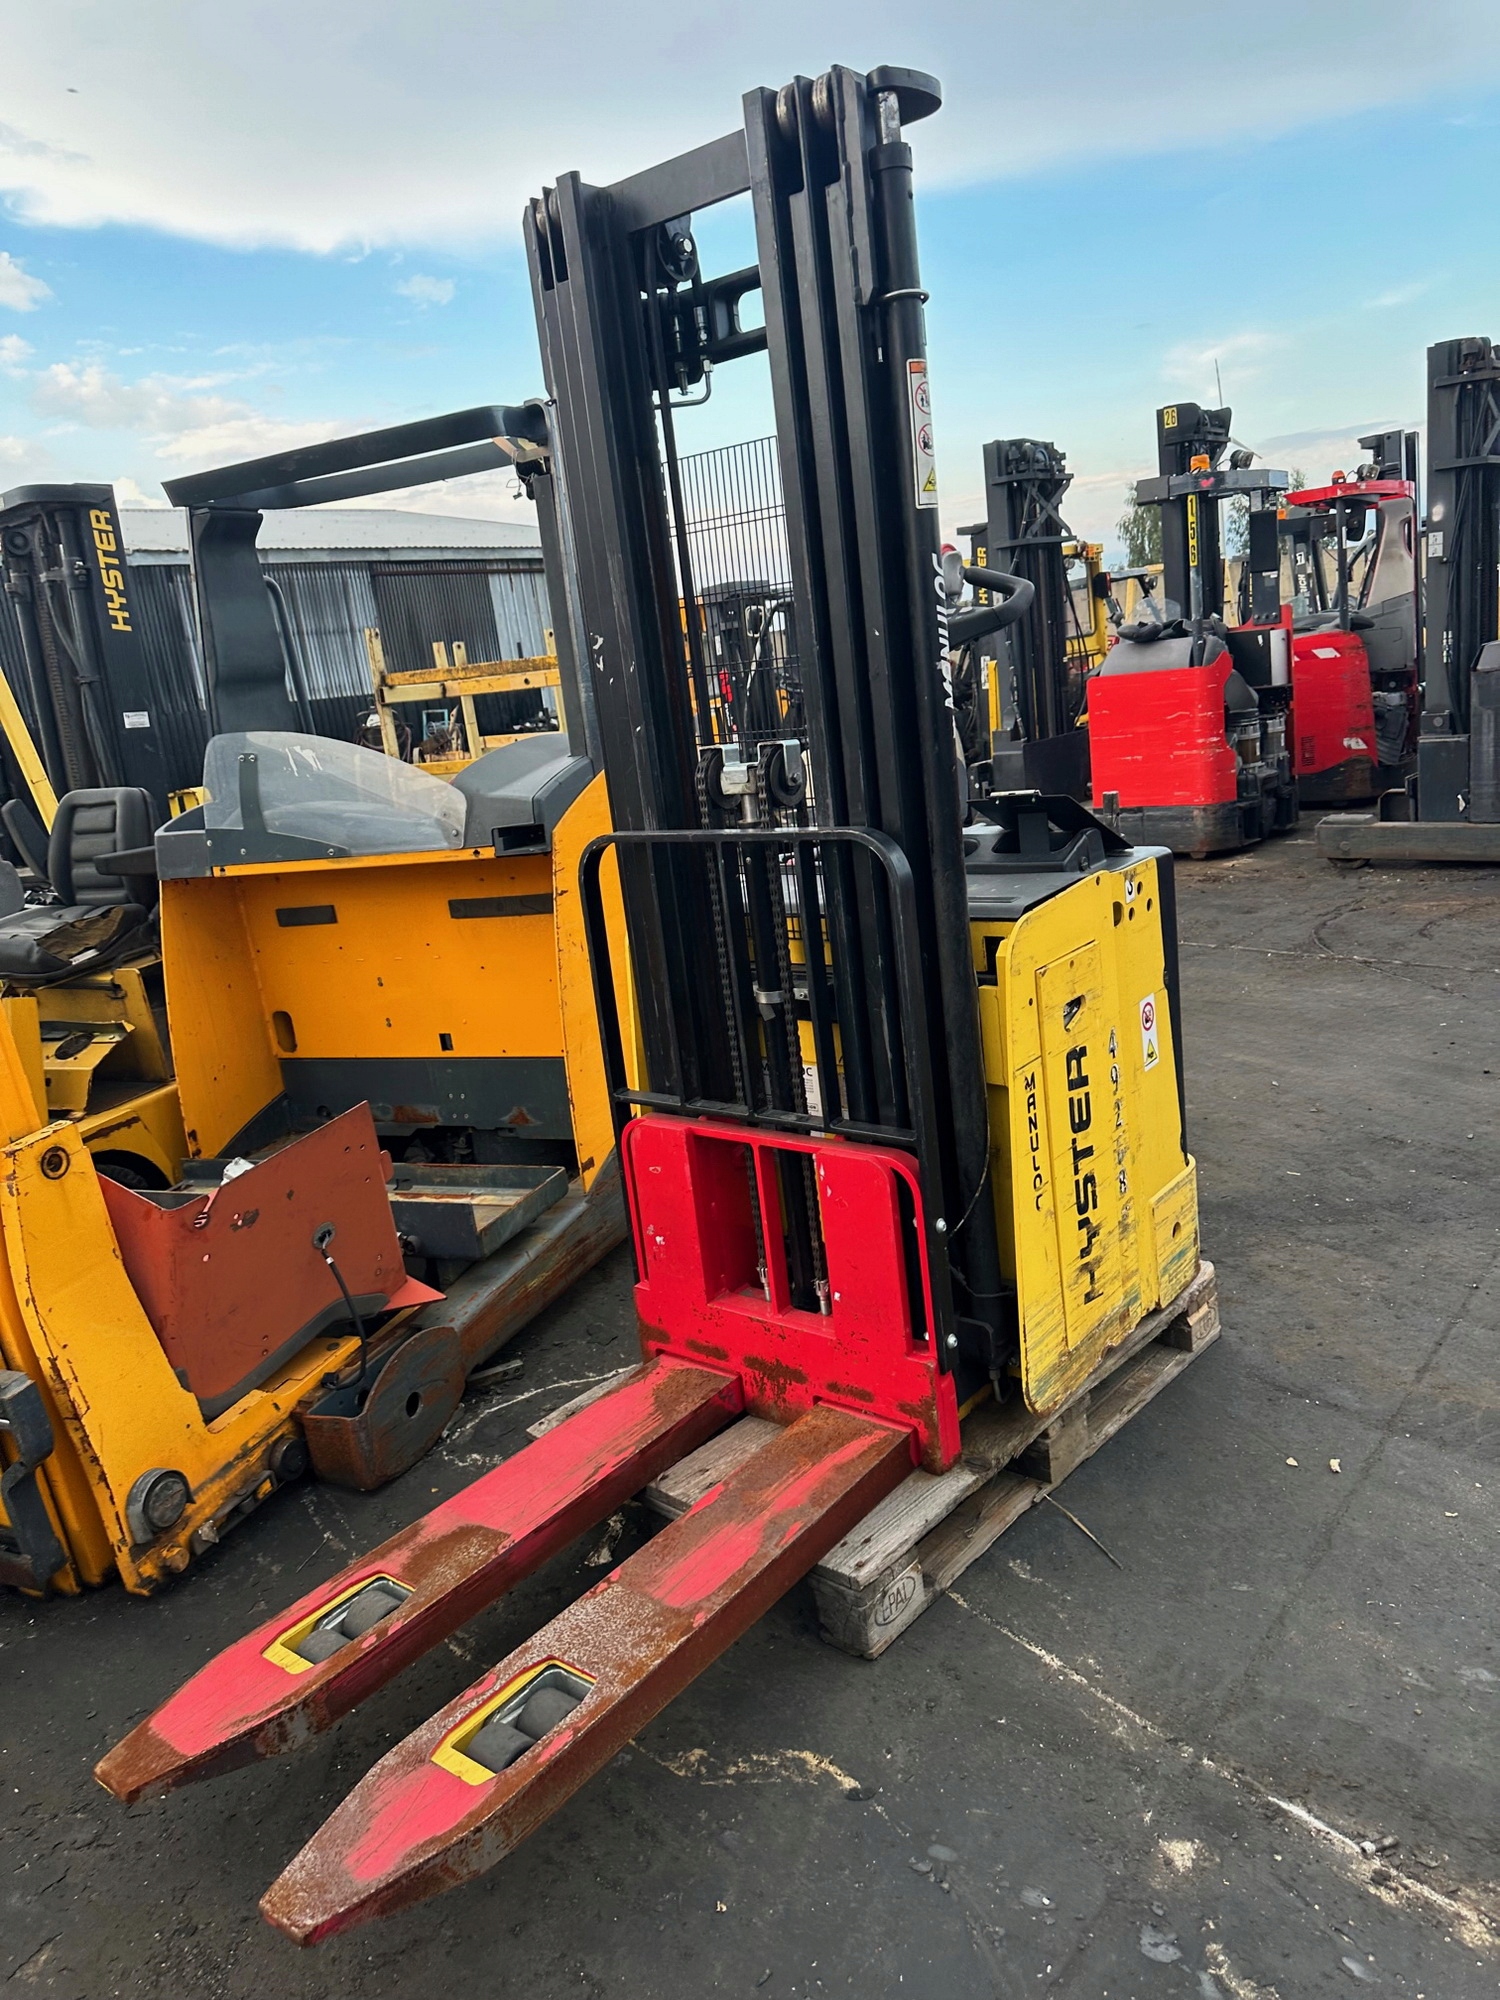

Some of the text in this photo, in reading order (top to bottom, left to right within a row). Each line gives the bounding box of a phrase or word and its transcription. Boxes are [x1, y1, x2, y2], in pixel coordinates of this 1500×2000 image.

[1165, 410, 1176, 426] 26
[89, 508, 133, 632] HYSTER
[976, 546, 989, 605] HYER
[1189, 499, 1197, 565] 156
[1024, 1071, 1043, 1212] MANULOC
[1065, 1045, 1104, 1306] HYSTER
